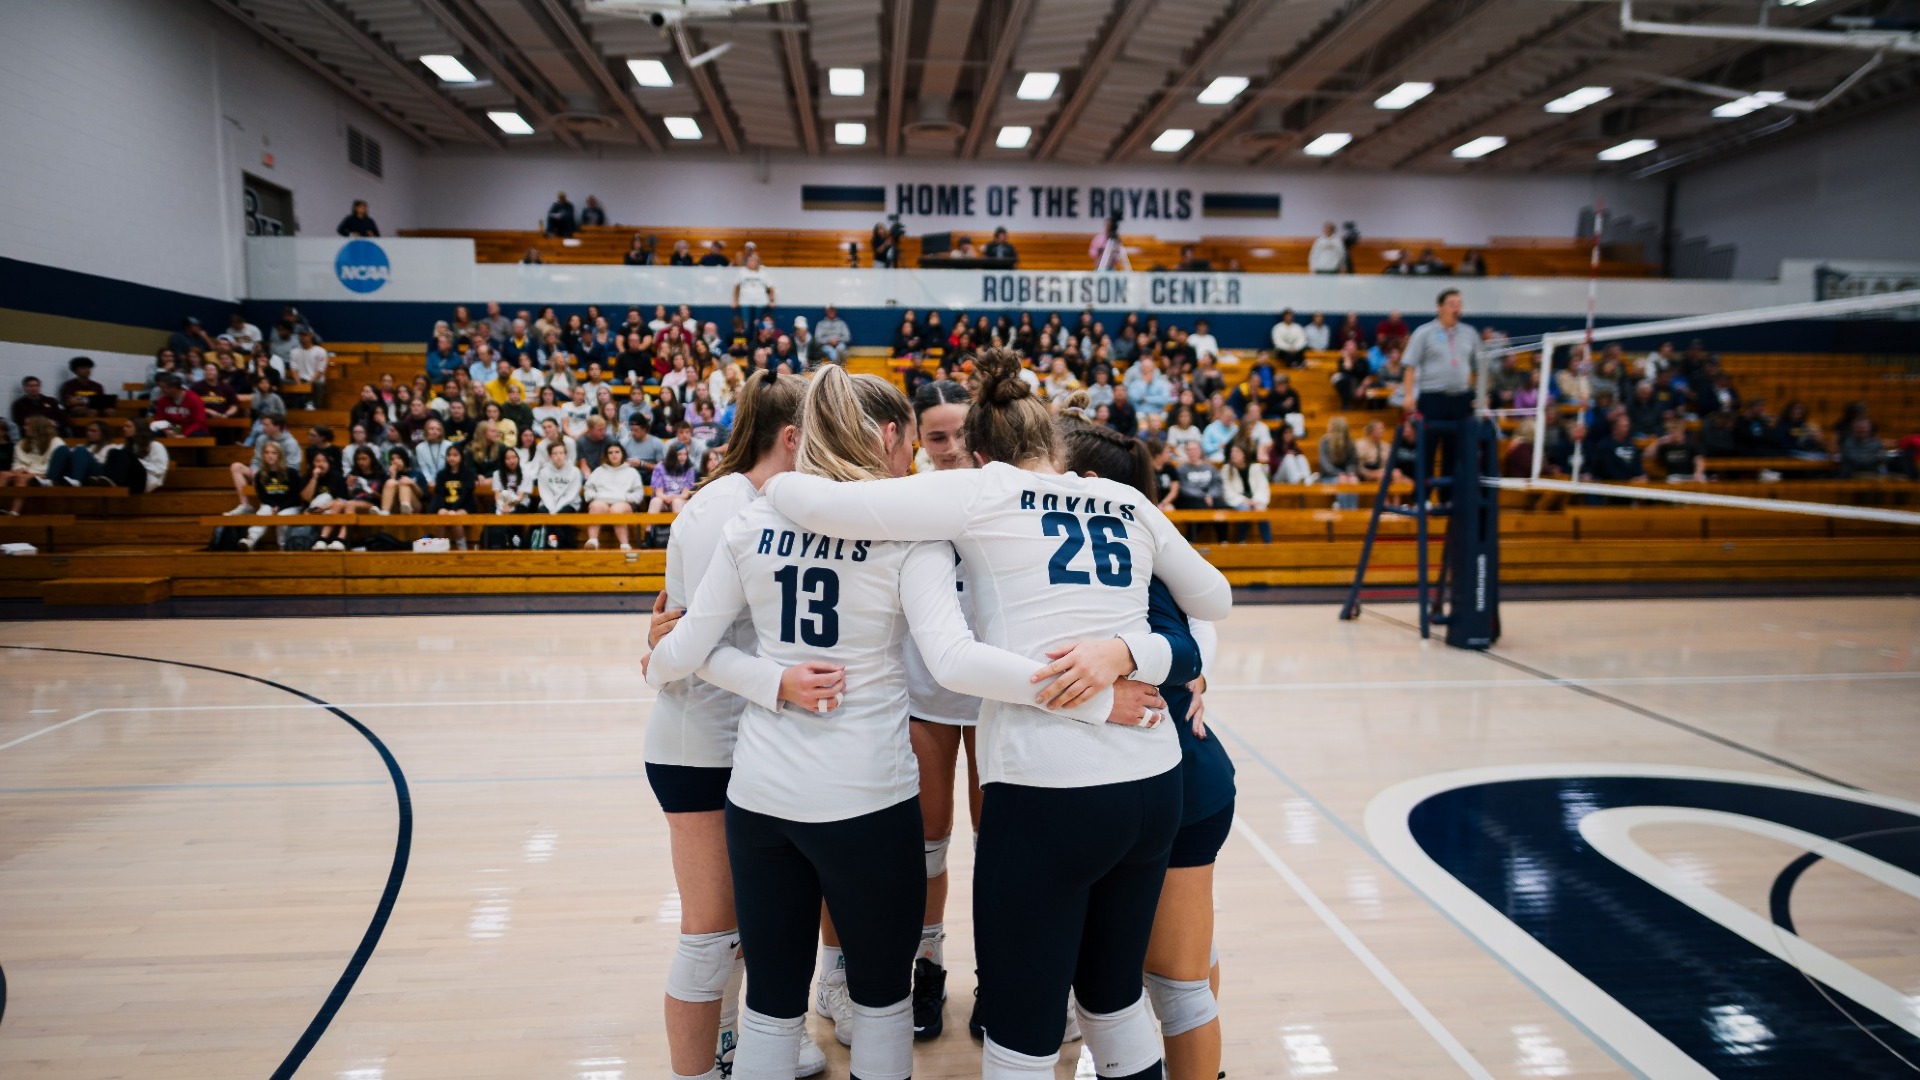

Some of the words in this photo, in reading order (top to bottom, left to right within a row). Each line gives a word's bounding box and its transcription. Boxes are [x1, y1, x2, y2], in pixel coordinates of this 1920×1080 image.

[896, 183, 975, 216] HOME
[986, 185, 1019, 217] OF
[1029, 186, 1079, 218] THE
[1089, 187, 1193, 219] ROYALS
[341, 264, 390, 281] NCAA
[983, 276, 1128, 303] ROBERTSON
[757, 528, 871, 562] ROYALS
[1041, 511, 1133, 588] 26
[774, 565, 840, 648] 13
